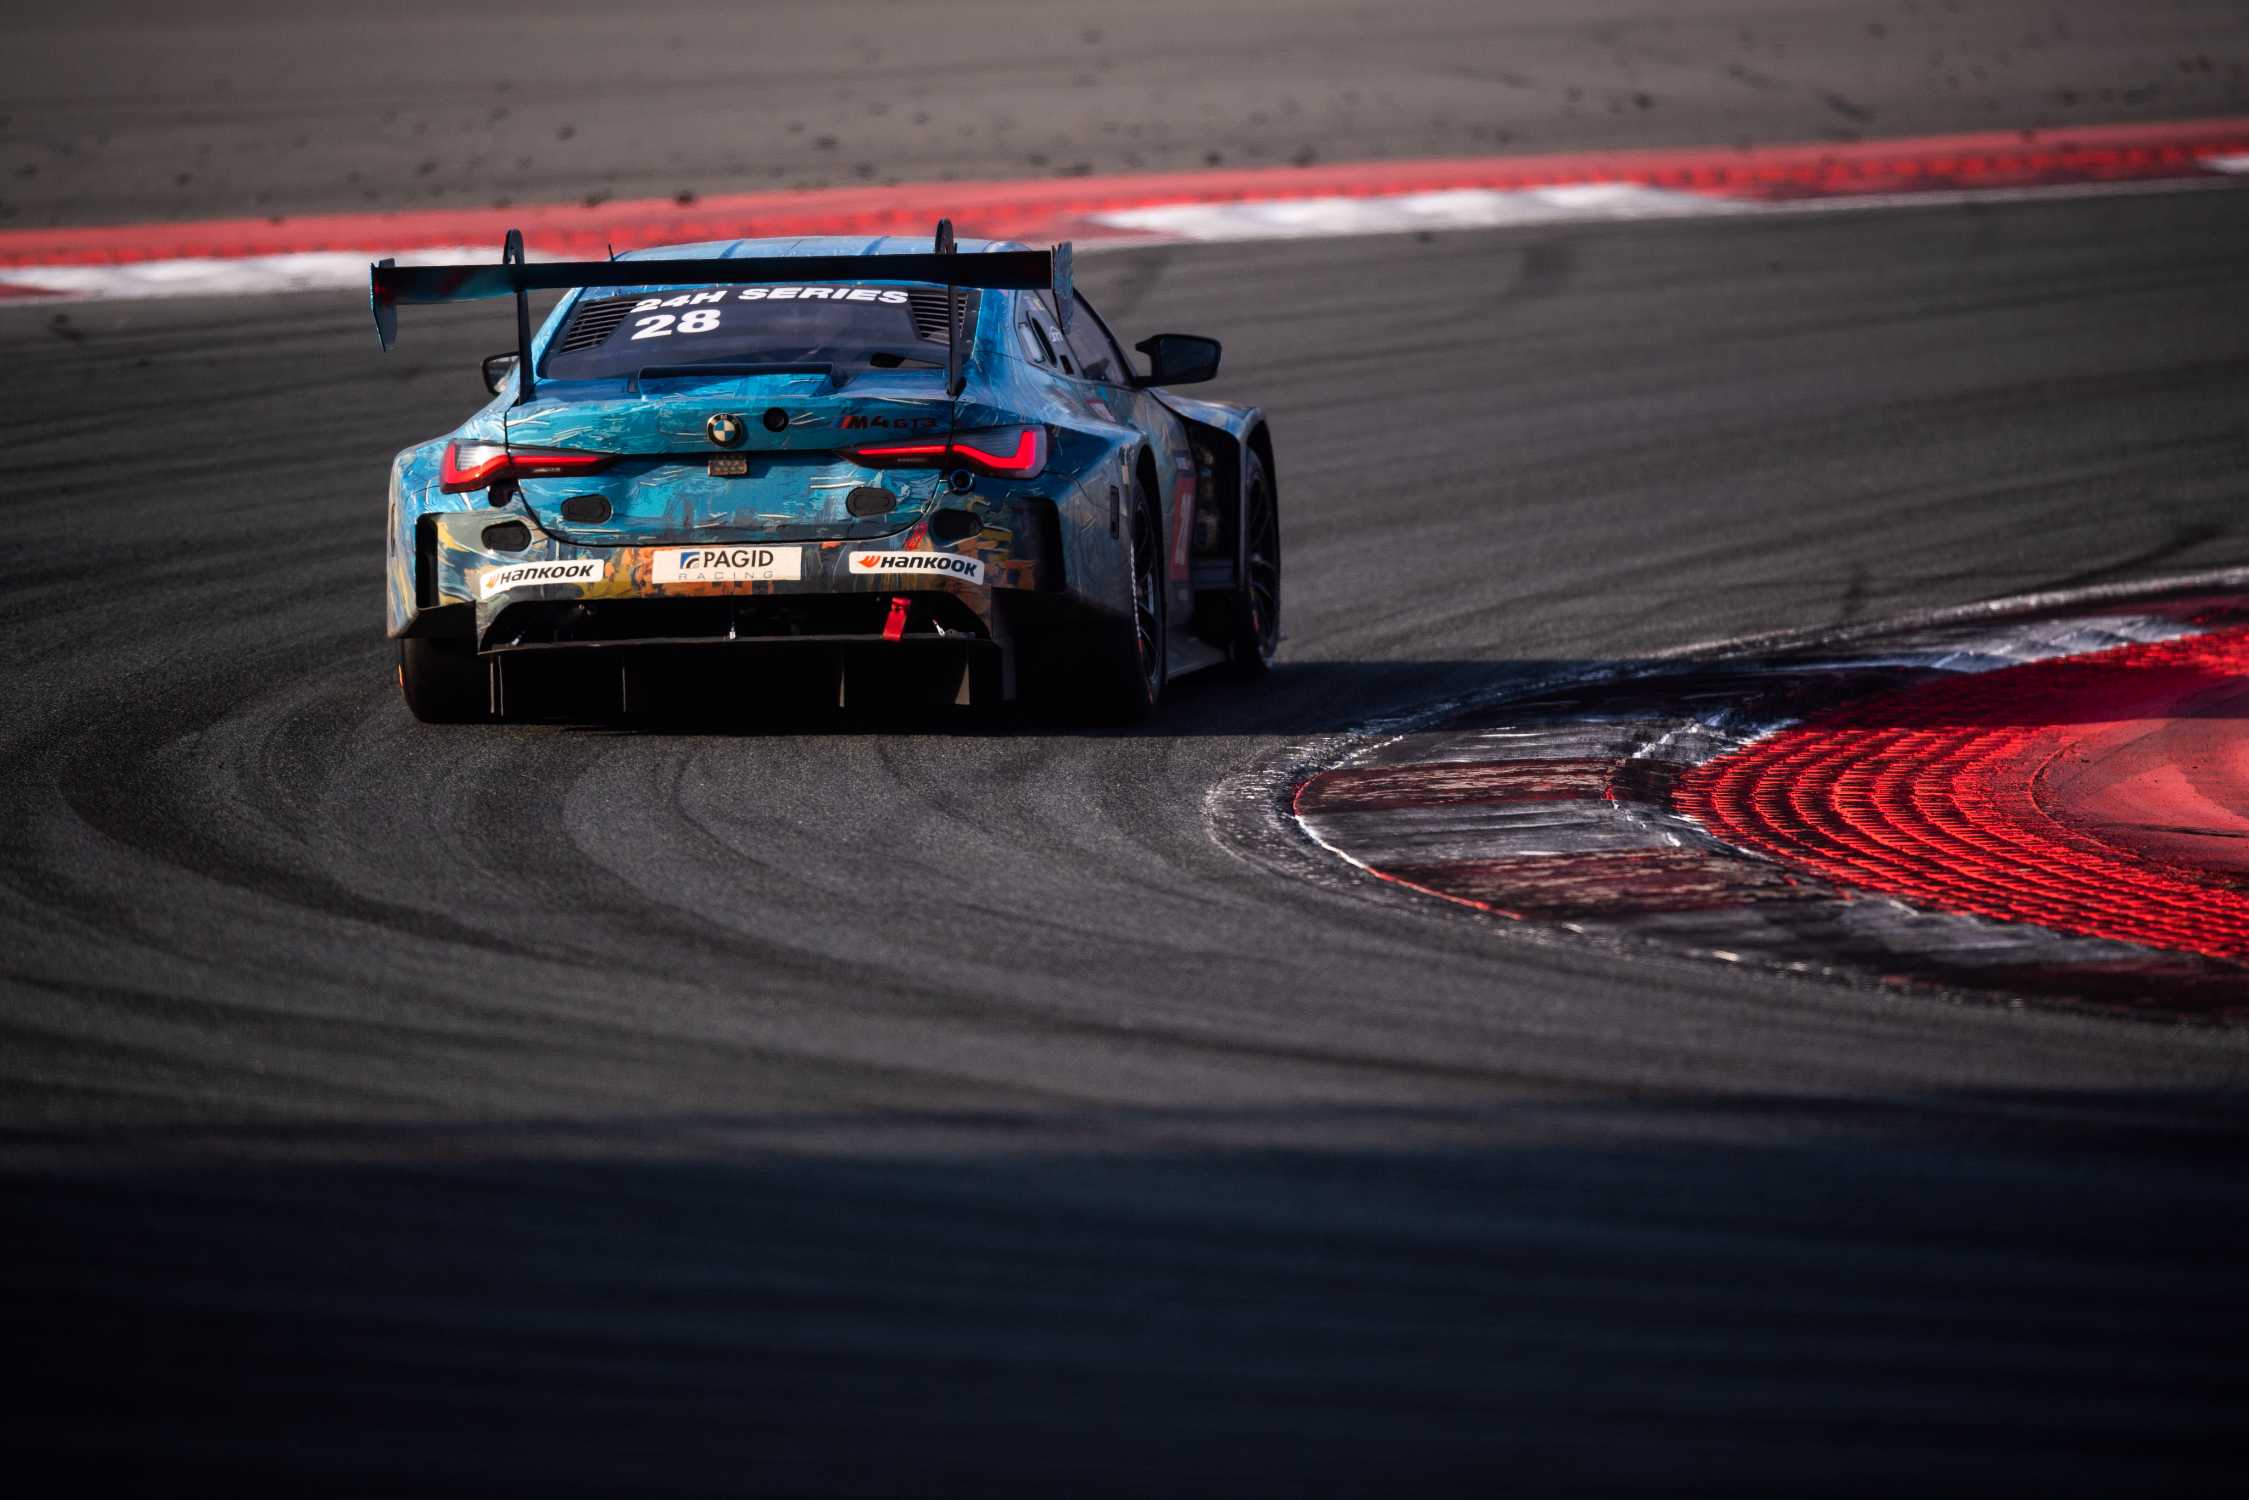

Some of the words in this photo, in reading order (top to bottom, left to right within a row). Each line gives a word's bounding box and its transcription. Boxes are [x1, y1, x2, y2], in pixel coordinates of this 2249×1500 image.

[630, 290, 728, 313] 24H
[738, 287, 909, 304] SERIES
[630, 309, 721, 340] 28
[703, 549, 774, 568] PAGID
[678, 570, 774, 581] RACING
